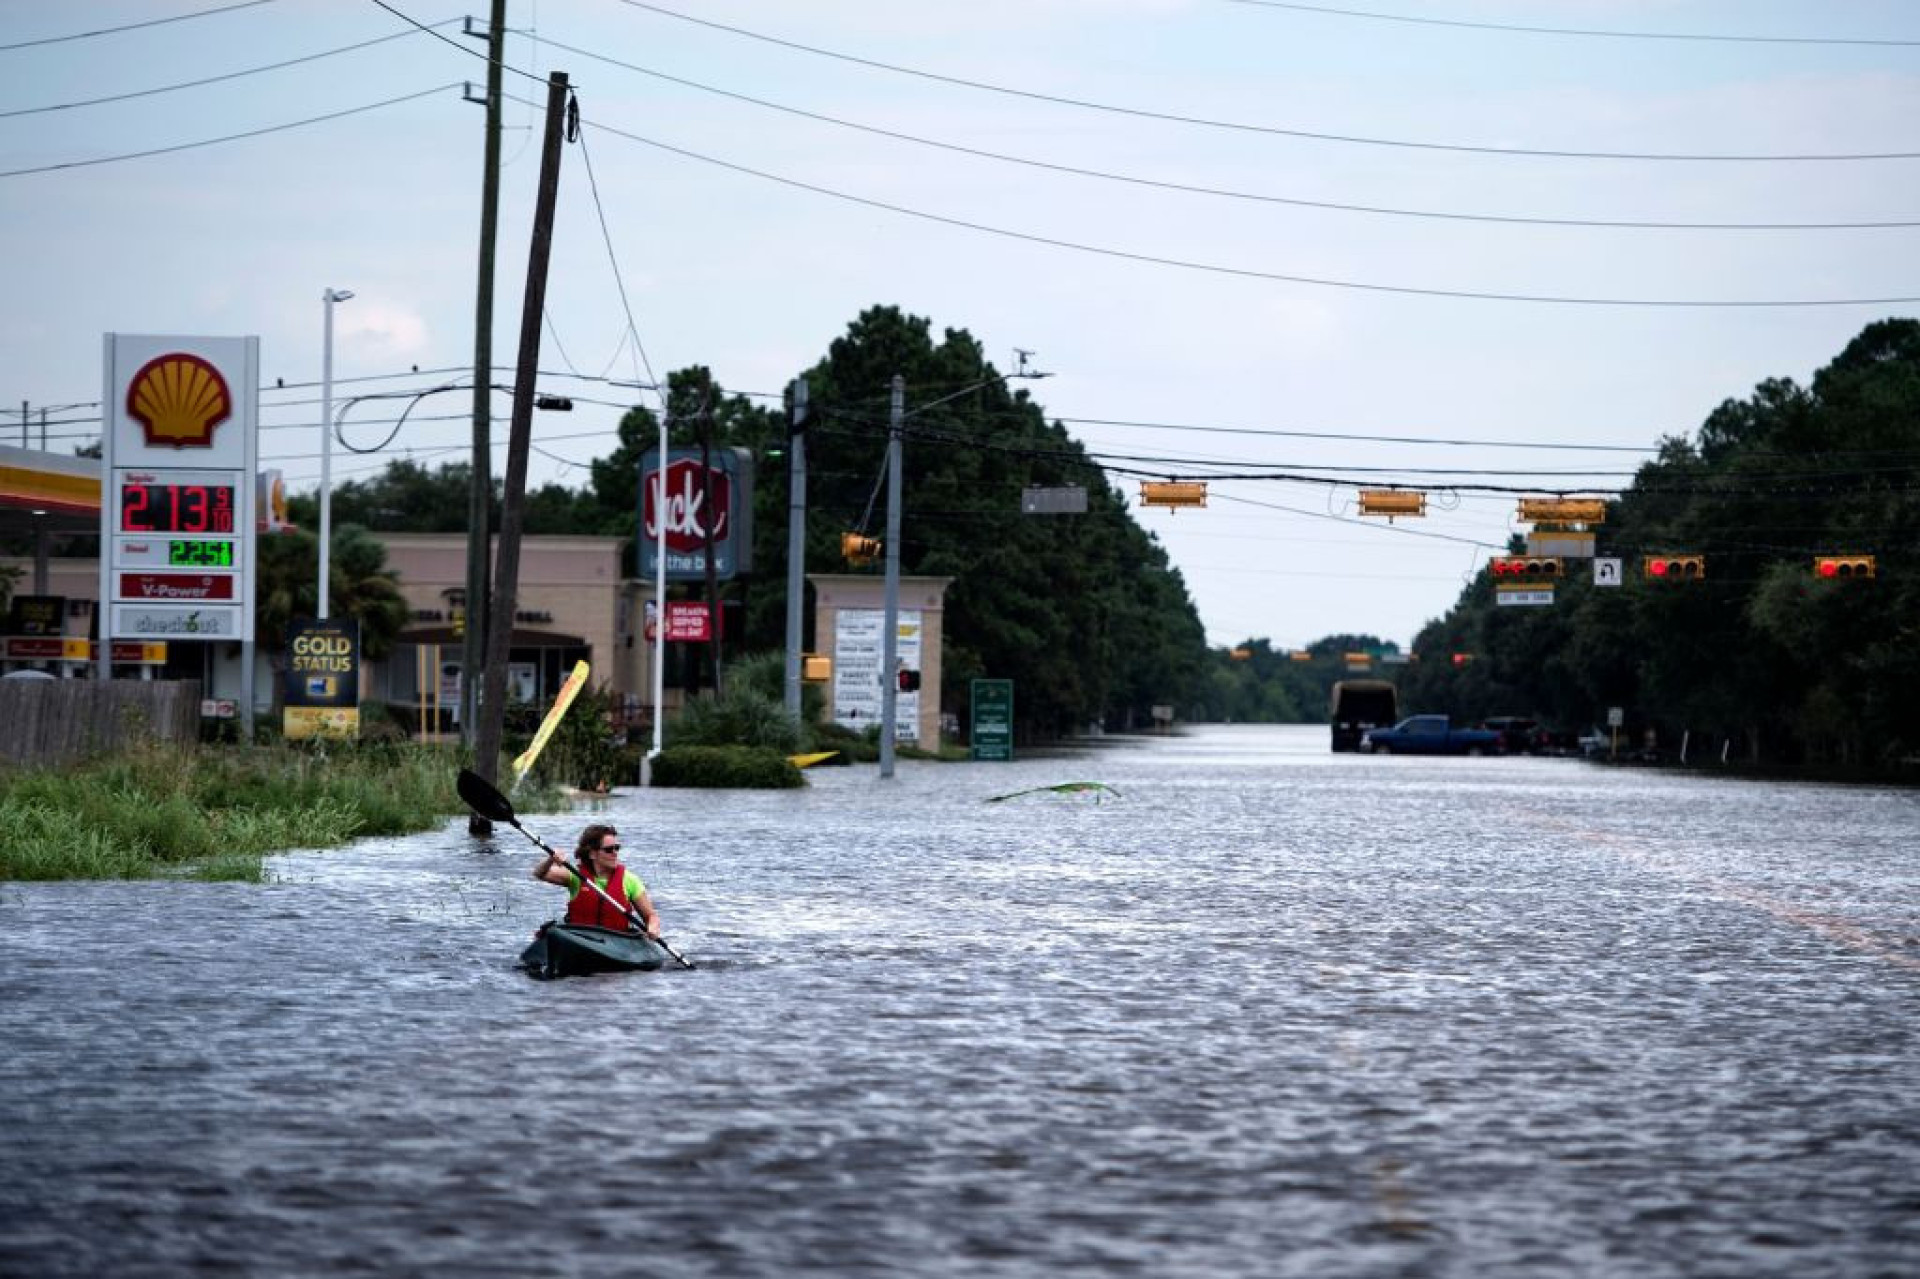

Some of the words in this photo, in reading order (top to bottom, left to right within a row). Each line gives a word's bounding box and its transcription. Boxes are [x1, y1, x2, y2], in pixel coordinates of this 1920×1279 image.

[695, 554, 724, 570] bx
[142, 584, 210, 597] V-Power
[293, 636, 352, 656] GOLD
[293, 656, 352, 672] STATUS
